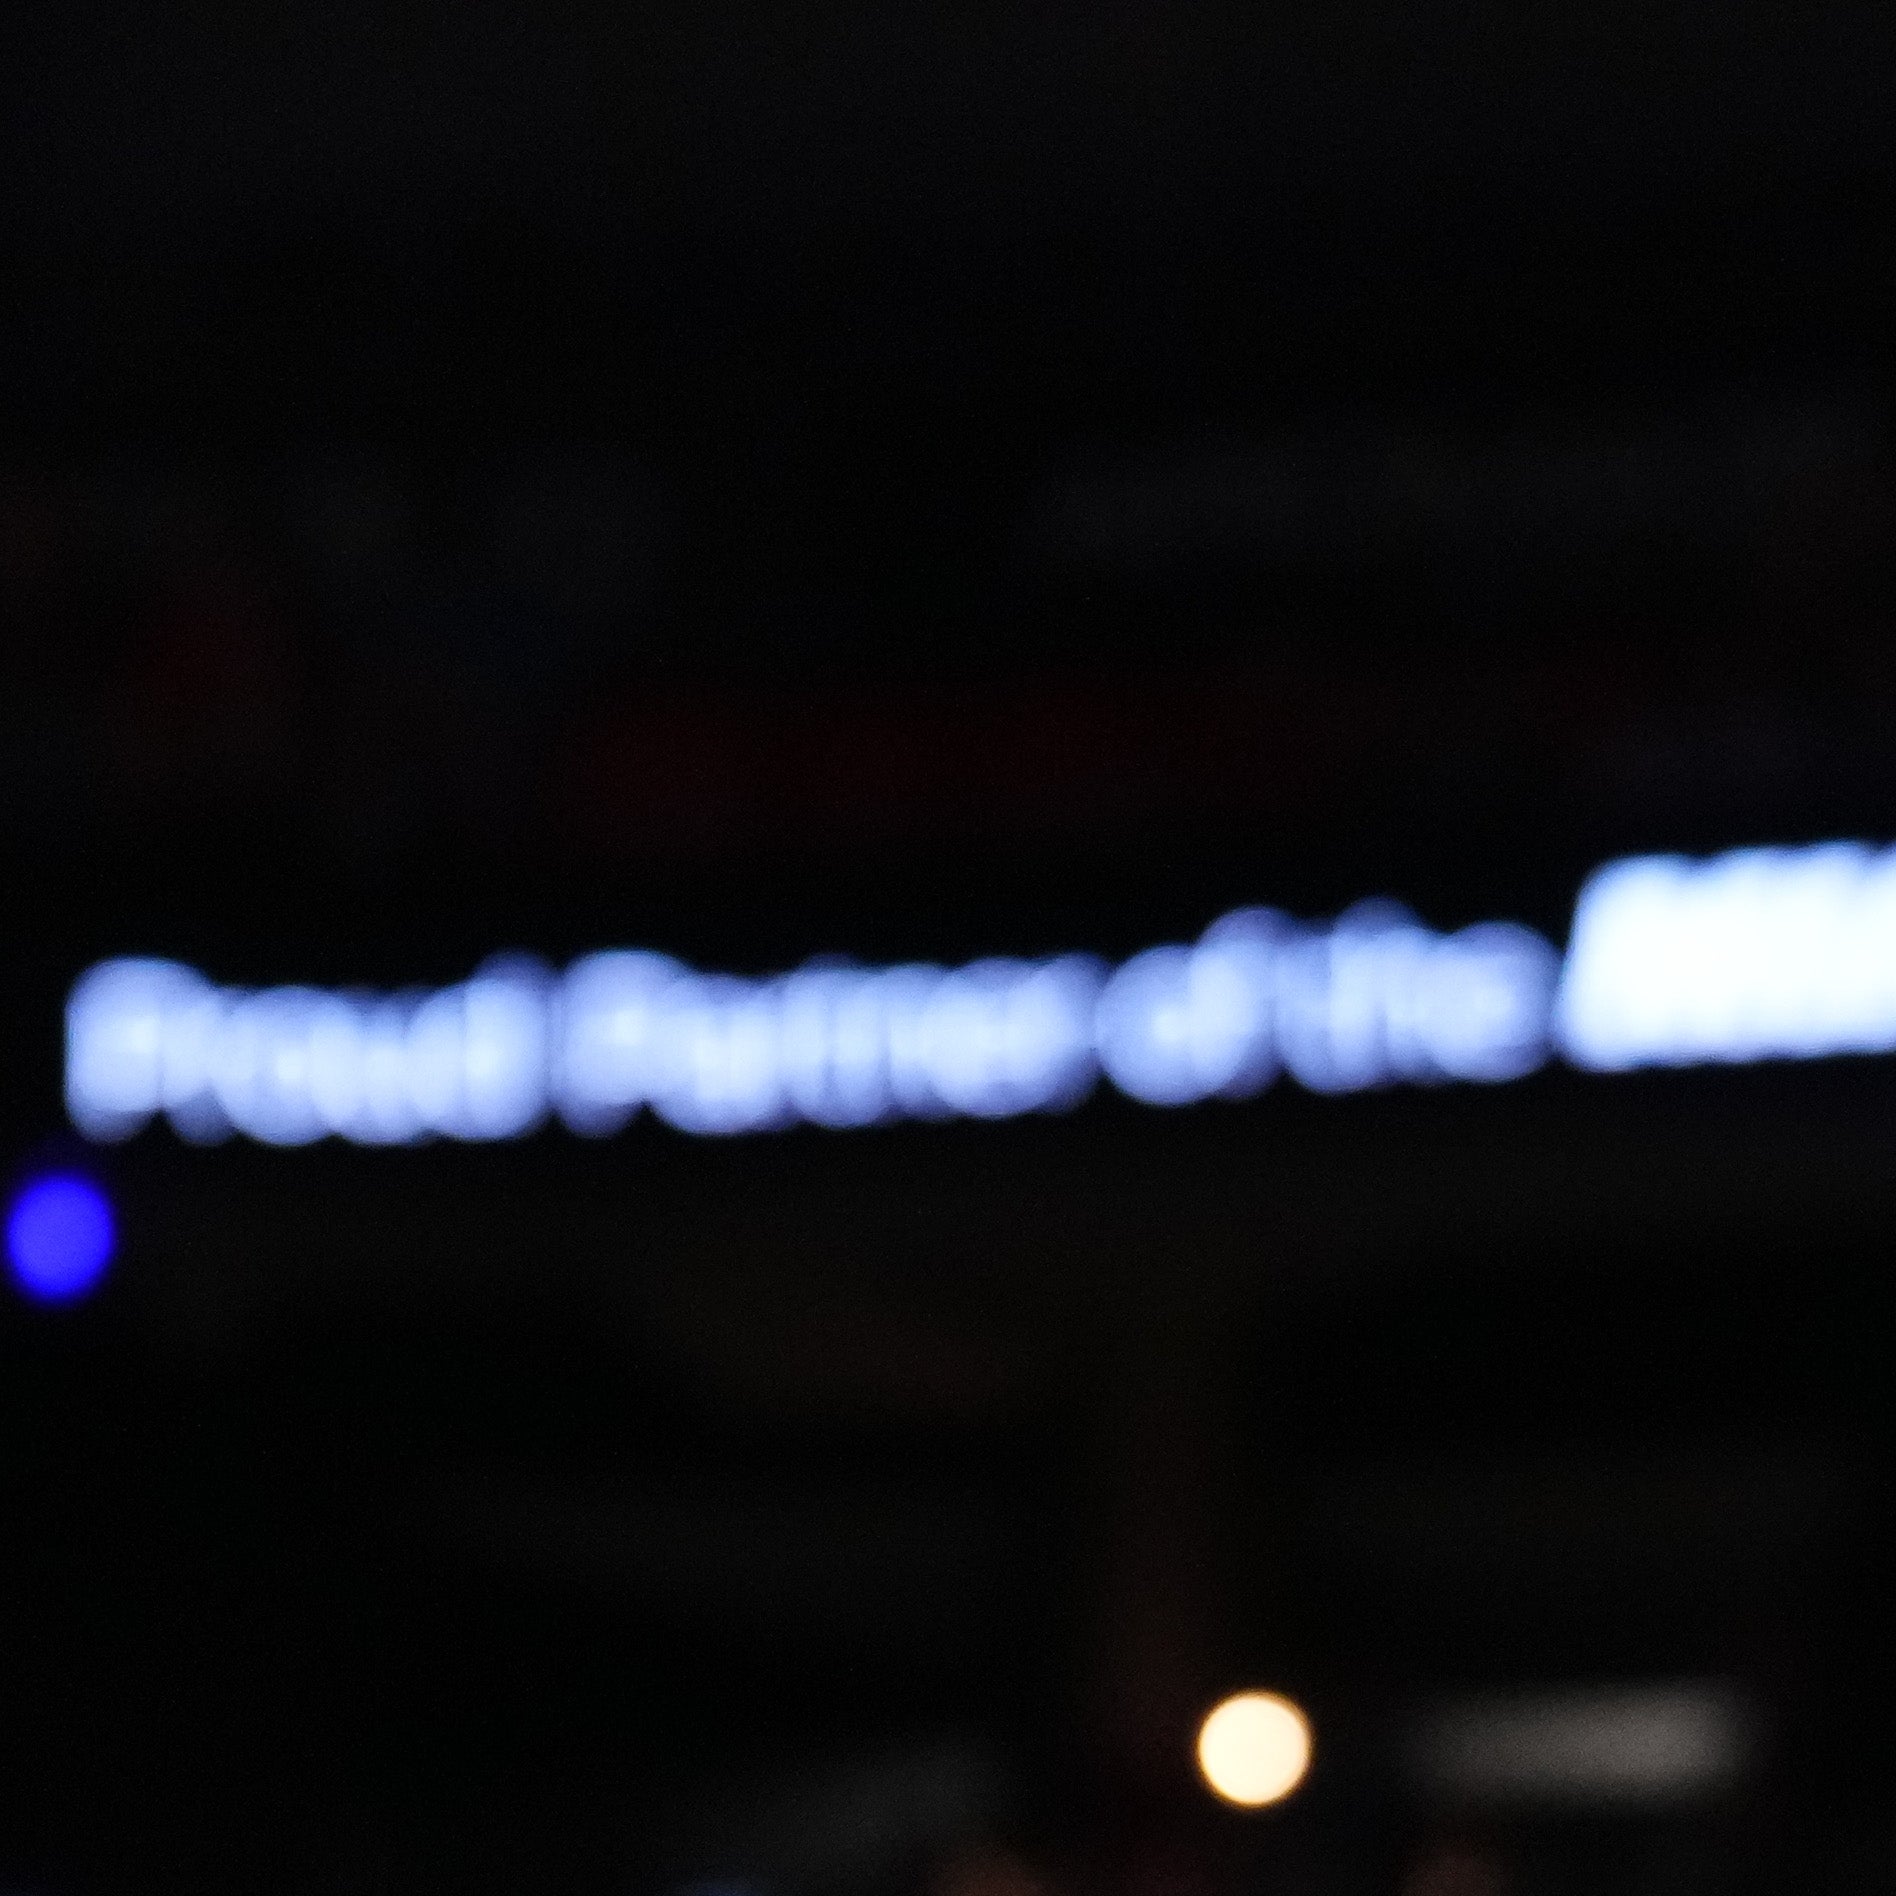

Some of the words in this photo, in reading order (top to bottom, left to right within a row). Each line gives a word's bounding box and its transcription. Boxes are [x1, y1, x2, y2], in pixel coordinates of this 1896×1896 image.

[66, 950, 556, 1146] Proud
[552, 948, 1104, 1138] Partner
[1094, 906, 1302, 1106] of
[1276, 897, 1564, 1096] the
